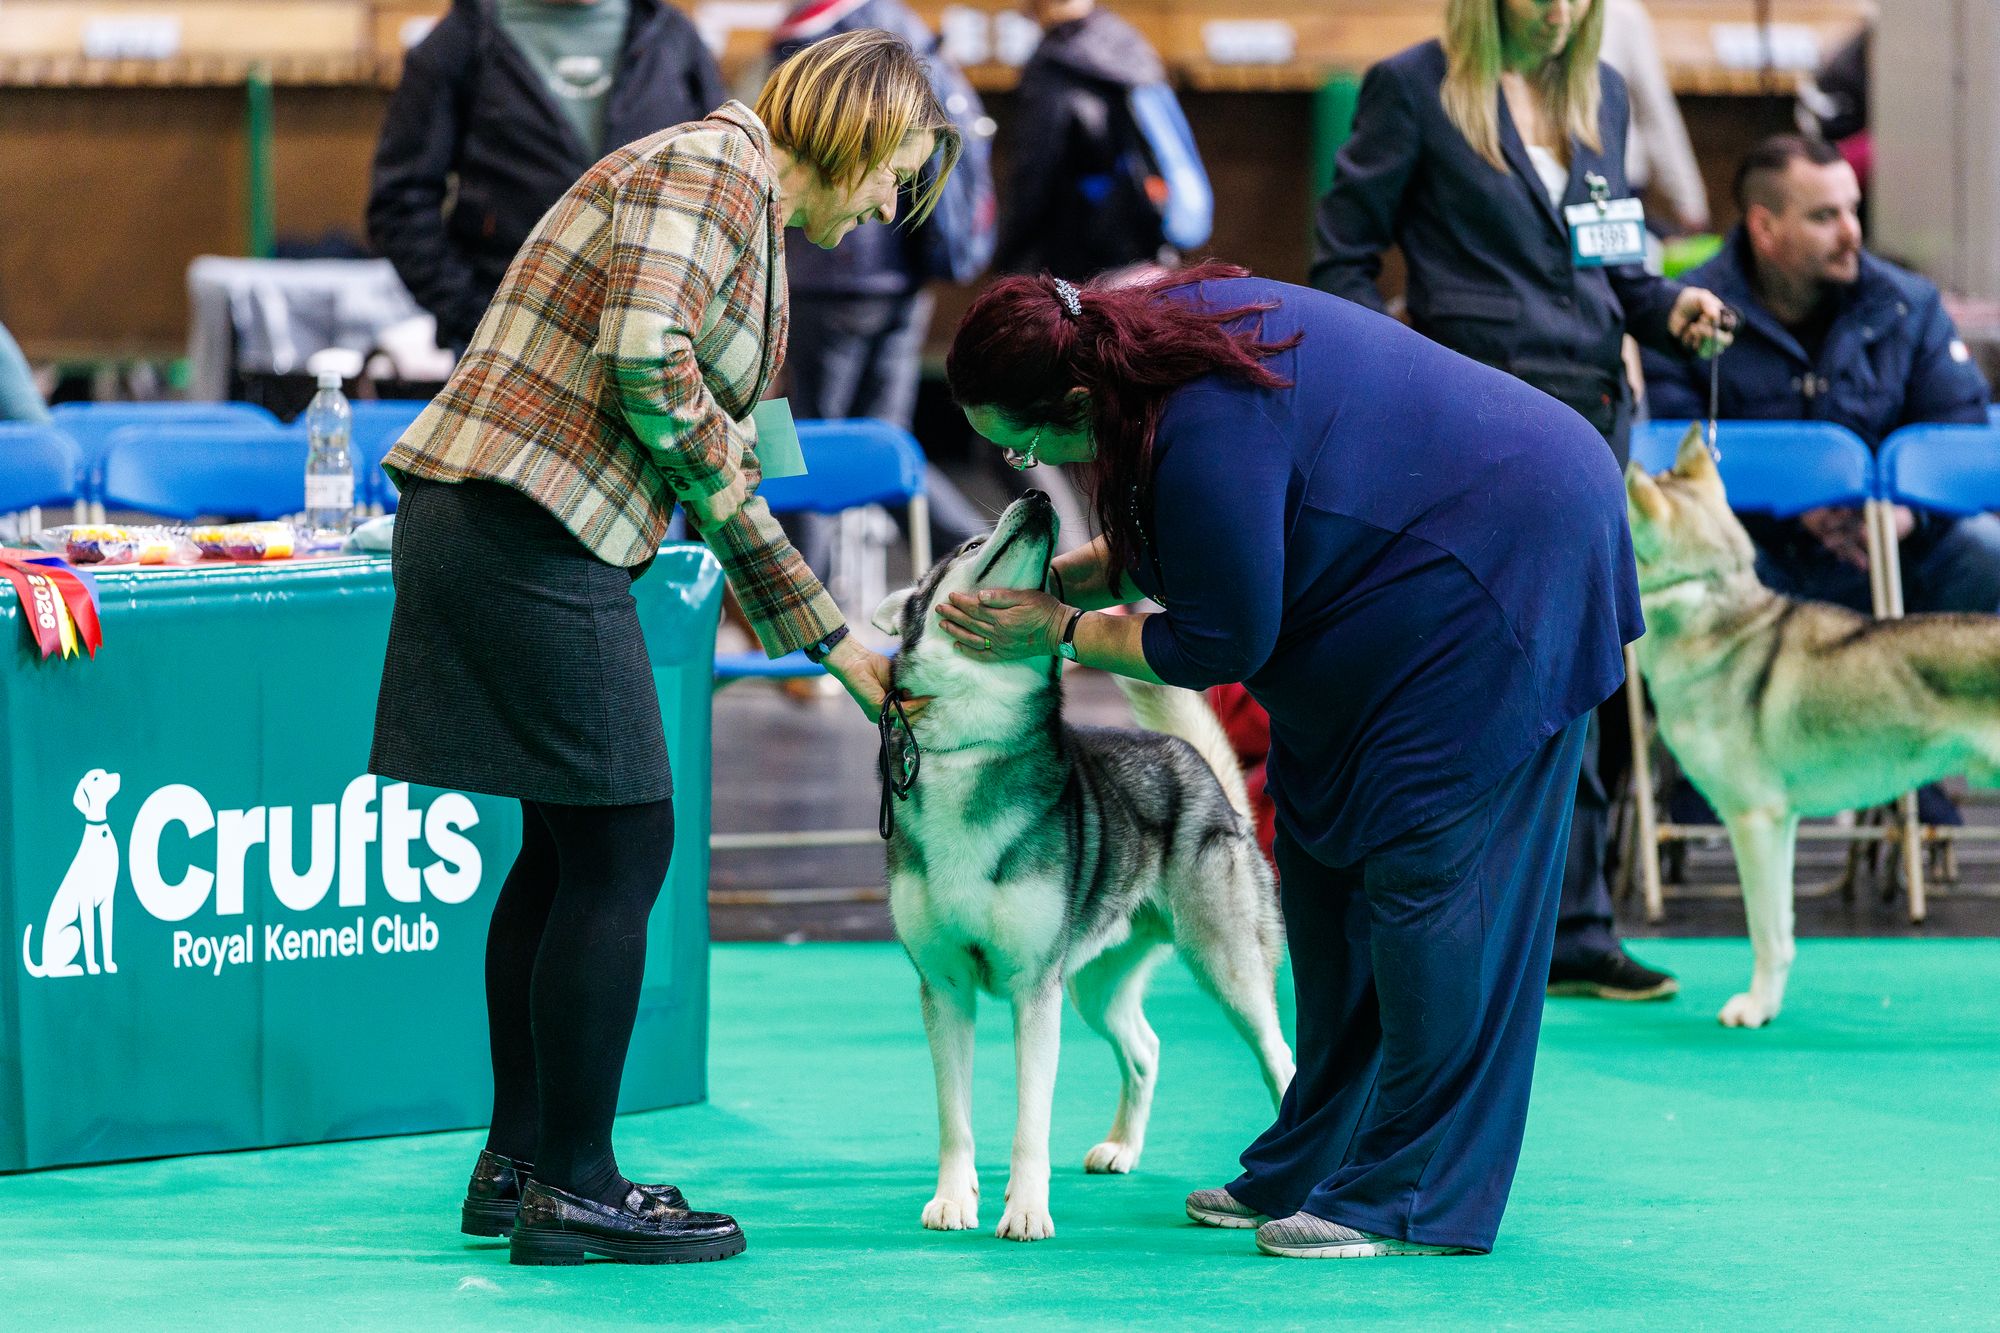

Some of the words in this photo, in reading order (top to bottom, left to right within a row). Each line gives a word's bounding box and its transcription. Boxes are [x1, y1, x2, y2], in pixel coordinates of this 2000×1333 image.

[27, 574, 56, 629] 2026
[129, 773, 482, 921] Crufts
[173, 924, 253, 976] Royal
[265, 917, 364, 961] Kennel
[371, 912, 439, 954] Club
